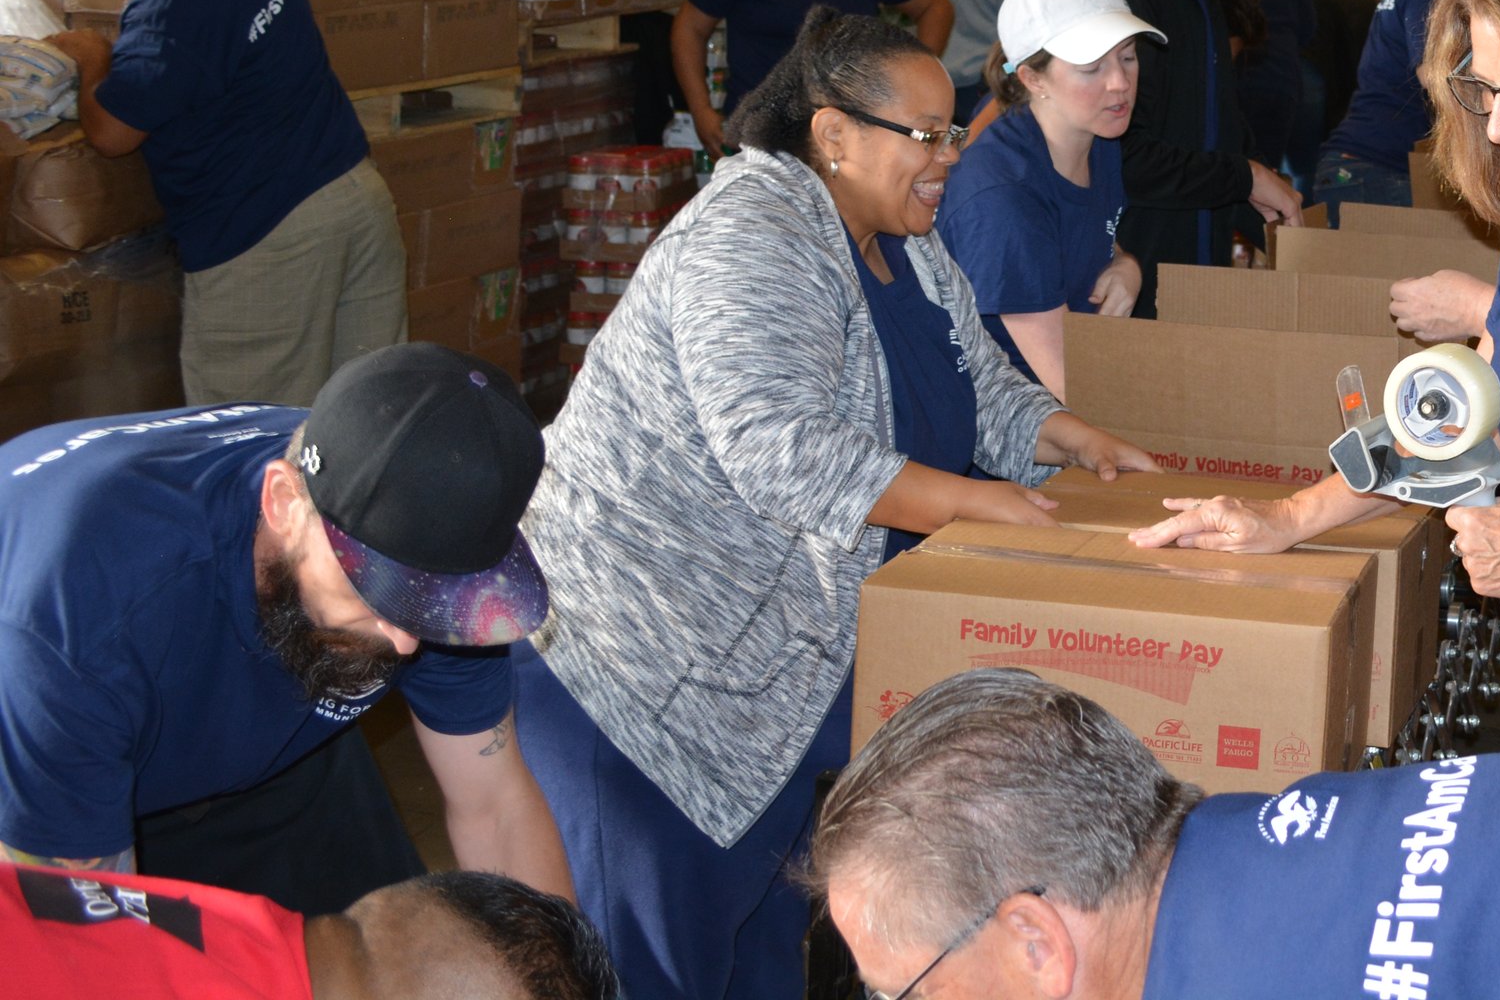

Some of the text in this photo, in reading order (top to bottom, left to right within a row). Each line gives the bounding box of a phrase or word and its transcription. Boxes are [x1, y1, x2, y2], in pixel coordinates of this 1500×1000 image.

[1195, 456, 1285, 480] Volunteer
[1290, 464, 1325, 484] Day
[959, 618, 1038, 650] Family
[1047, 627, 1172, 661] Volunteer
[1179, 638, 1225, 668] Day
[1142, 736, 1204, 753] PACIFIC LIFE
[1223, 737, 1255, 749] WELLS
[1223, 746, 1254, 758] FARGO
